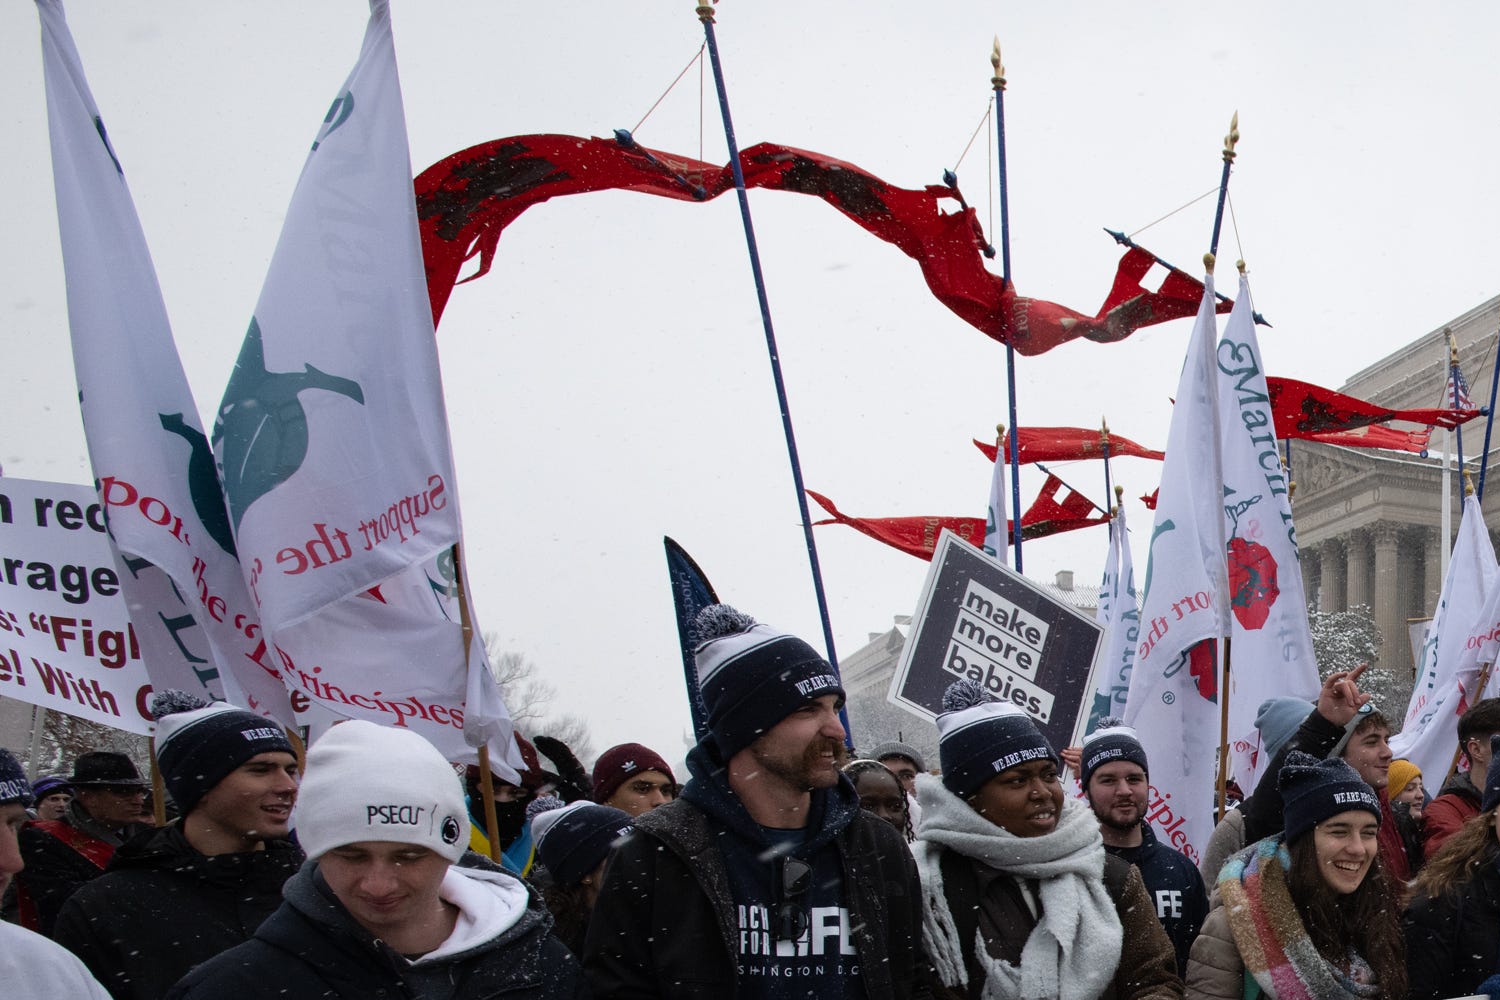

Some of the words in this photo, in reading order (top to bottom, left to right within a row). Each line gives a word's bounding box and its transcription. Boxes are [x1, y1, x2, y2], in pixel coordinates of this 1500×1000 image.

[966, 591, 1041, 646] make
[958, 618, 1033, 670] more
[31, 655, 121, 718] With
[812, 675, 828, 693] ARE
[947, 643, 1048, 720] babies.
[992, 757, 1006, 772] WE
[1005, 752, 1022, 768] ARE
[1333, 792, 1345, 804] WE
[1346, 791, 1360, 802] ARE
[740, 930, 771, 956] FOR
[738, 964, 825, 978] SHINGTON
